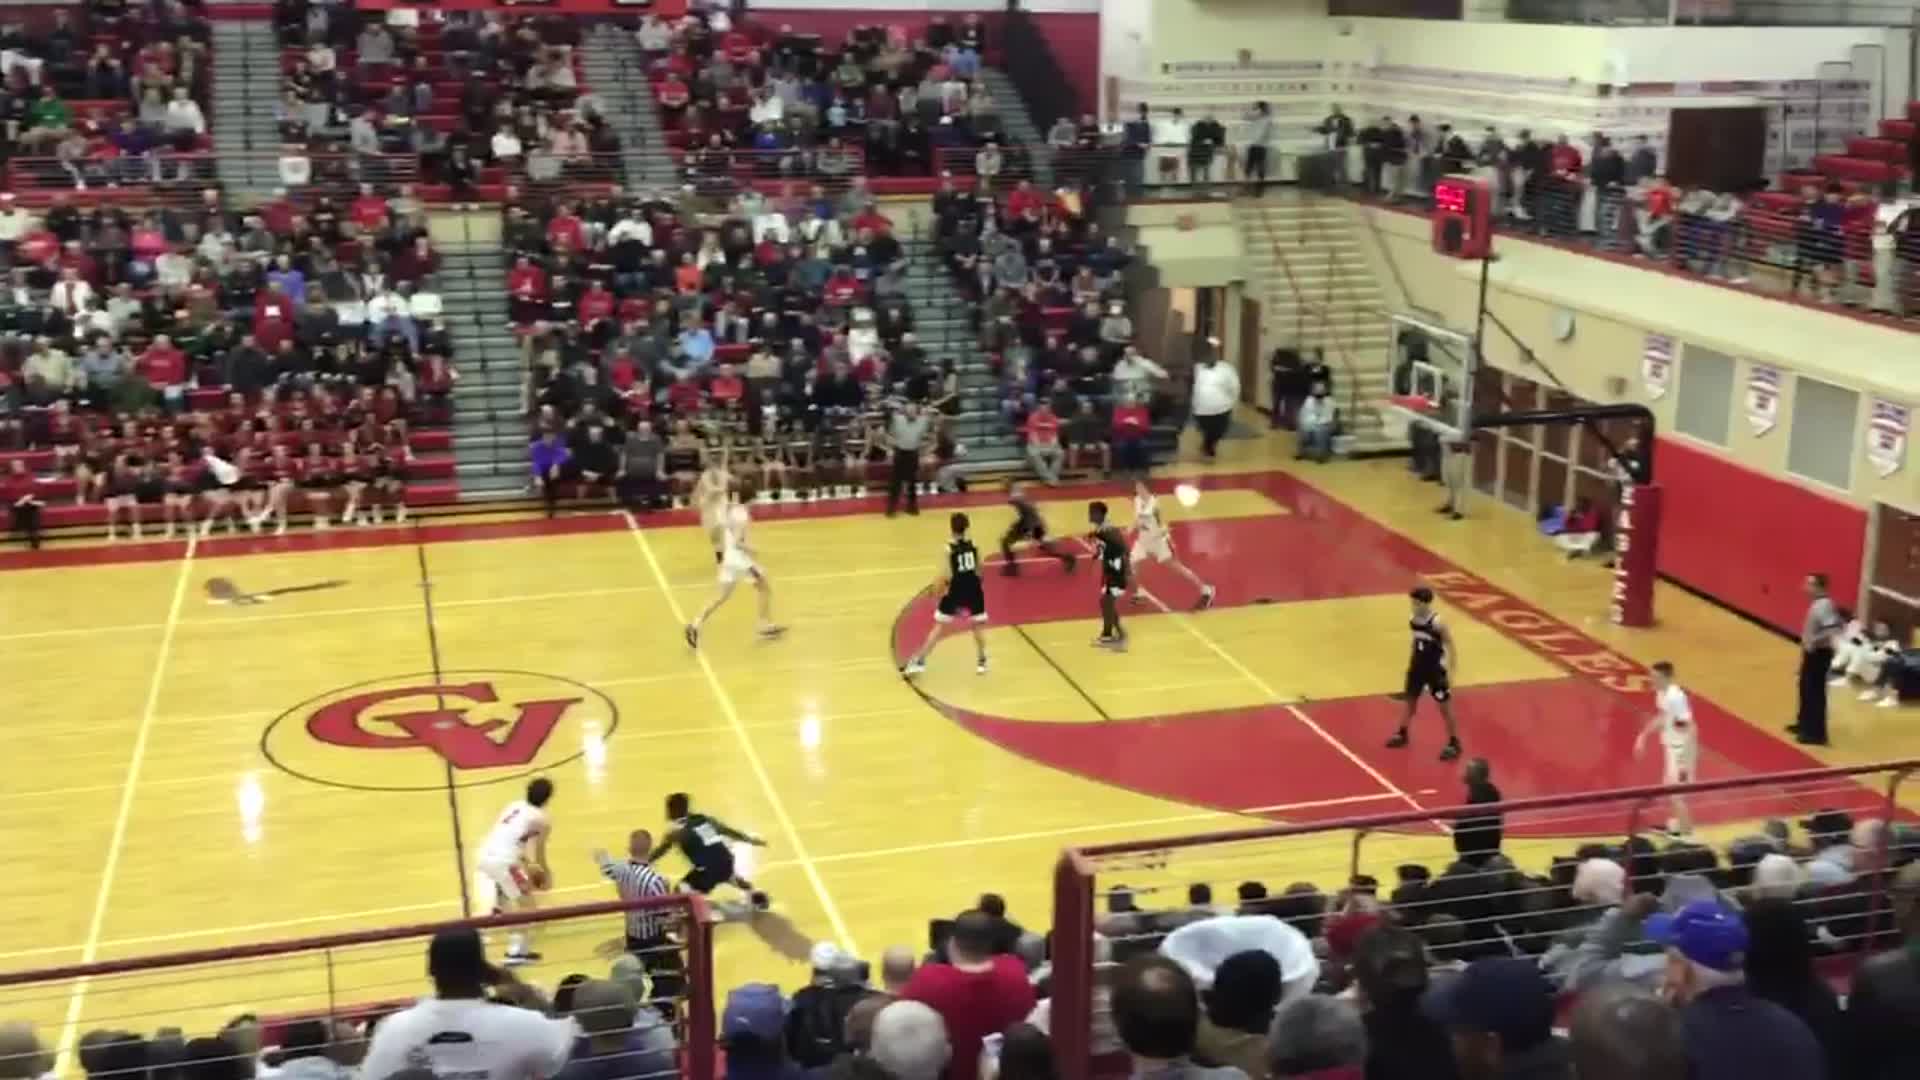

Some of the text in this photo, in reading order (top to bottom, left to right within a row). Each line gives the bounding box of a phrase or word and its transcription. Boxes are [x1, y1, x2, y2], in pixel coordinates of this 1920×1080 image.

[1610, 485, 1636, 624] EAGLES
[1416, 570, 1653, 693] EAGLES
[305, 681, 584, 770] CV
